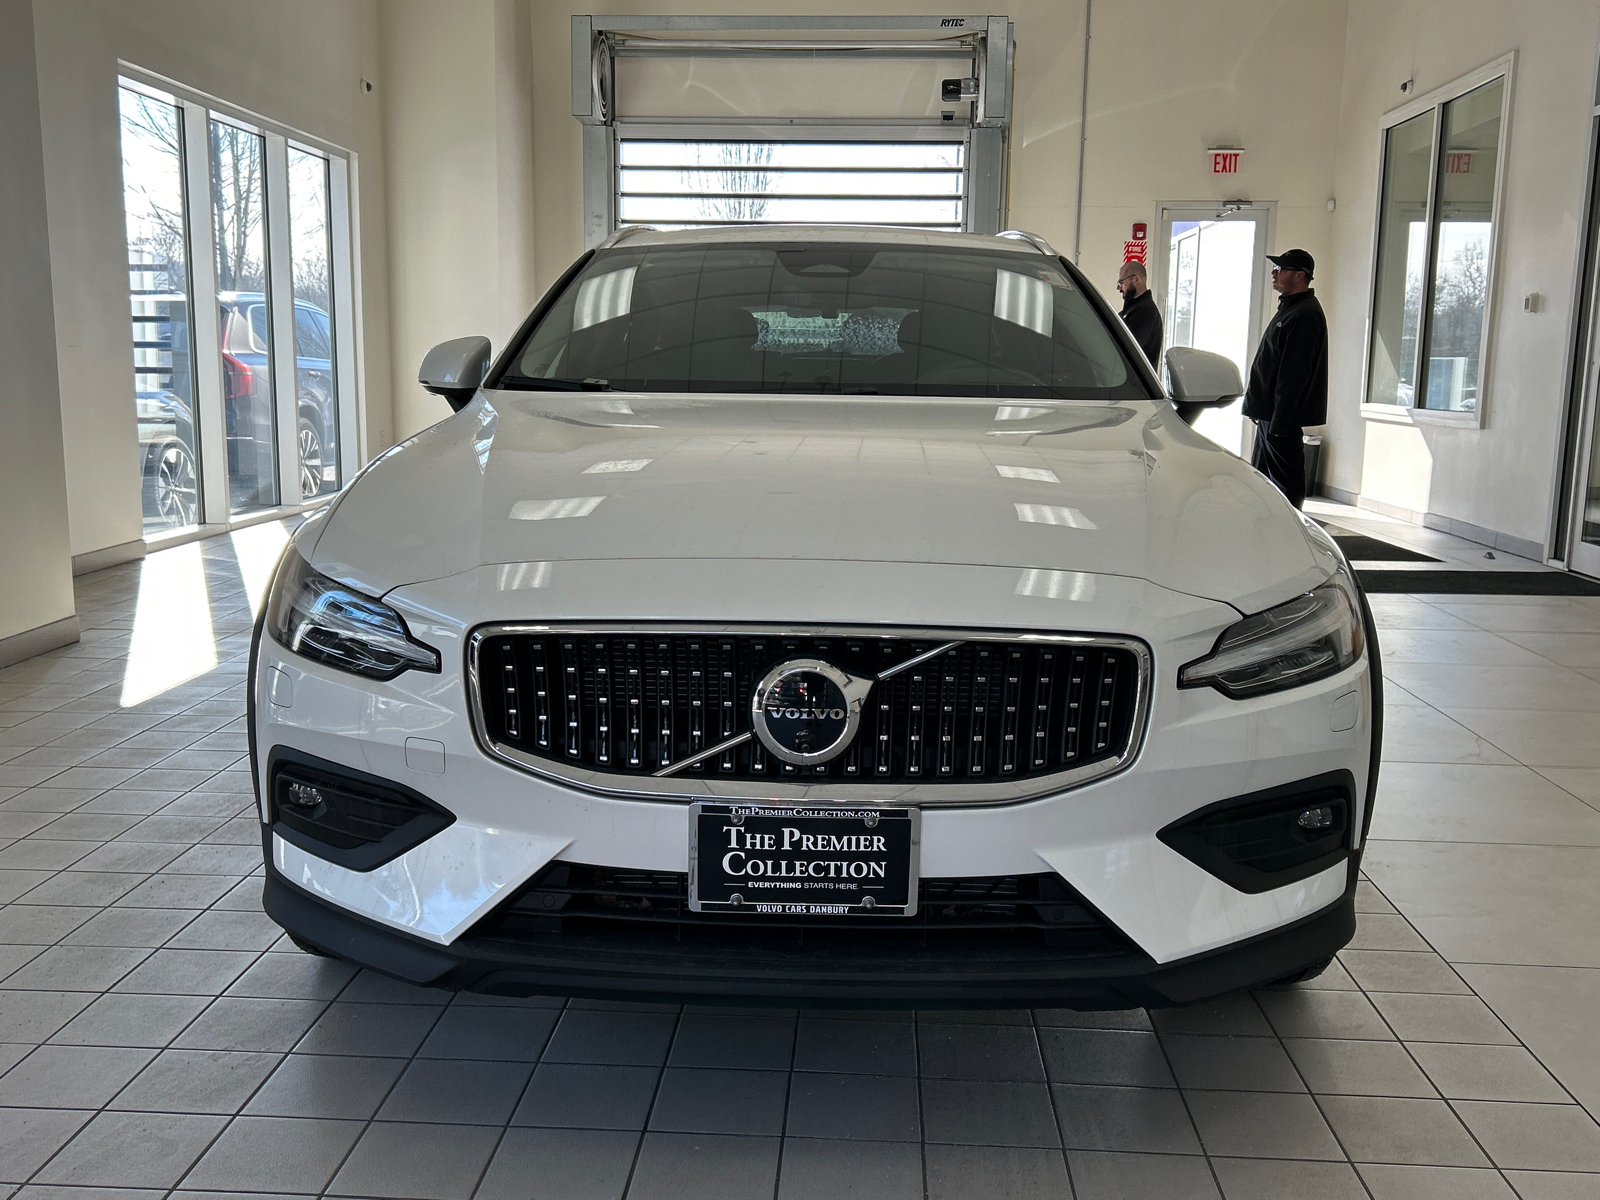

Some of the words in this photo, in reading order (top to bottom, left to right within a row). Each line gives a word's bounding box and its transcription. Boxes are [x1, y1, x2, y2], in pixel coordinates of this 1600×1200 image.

[940, 18, 965, 27] RYTEC
[1213, 153, 1240, 173] EXIT
[767, 707, 845, 720] VOLVO
[722, 826, 777, 850] THE
[780, 828, 888, 852] PREMIER
[722, 851, 887, 878] COLLECTION
[748, 881, 802, 889] EVERYTHING
[803, 882, 834, 890] STARTS
[756, 904, 783, 913] VOLVO
[785, 904, 807, 914] CARS
[810, 905, 849, 914] DANBURY
